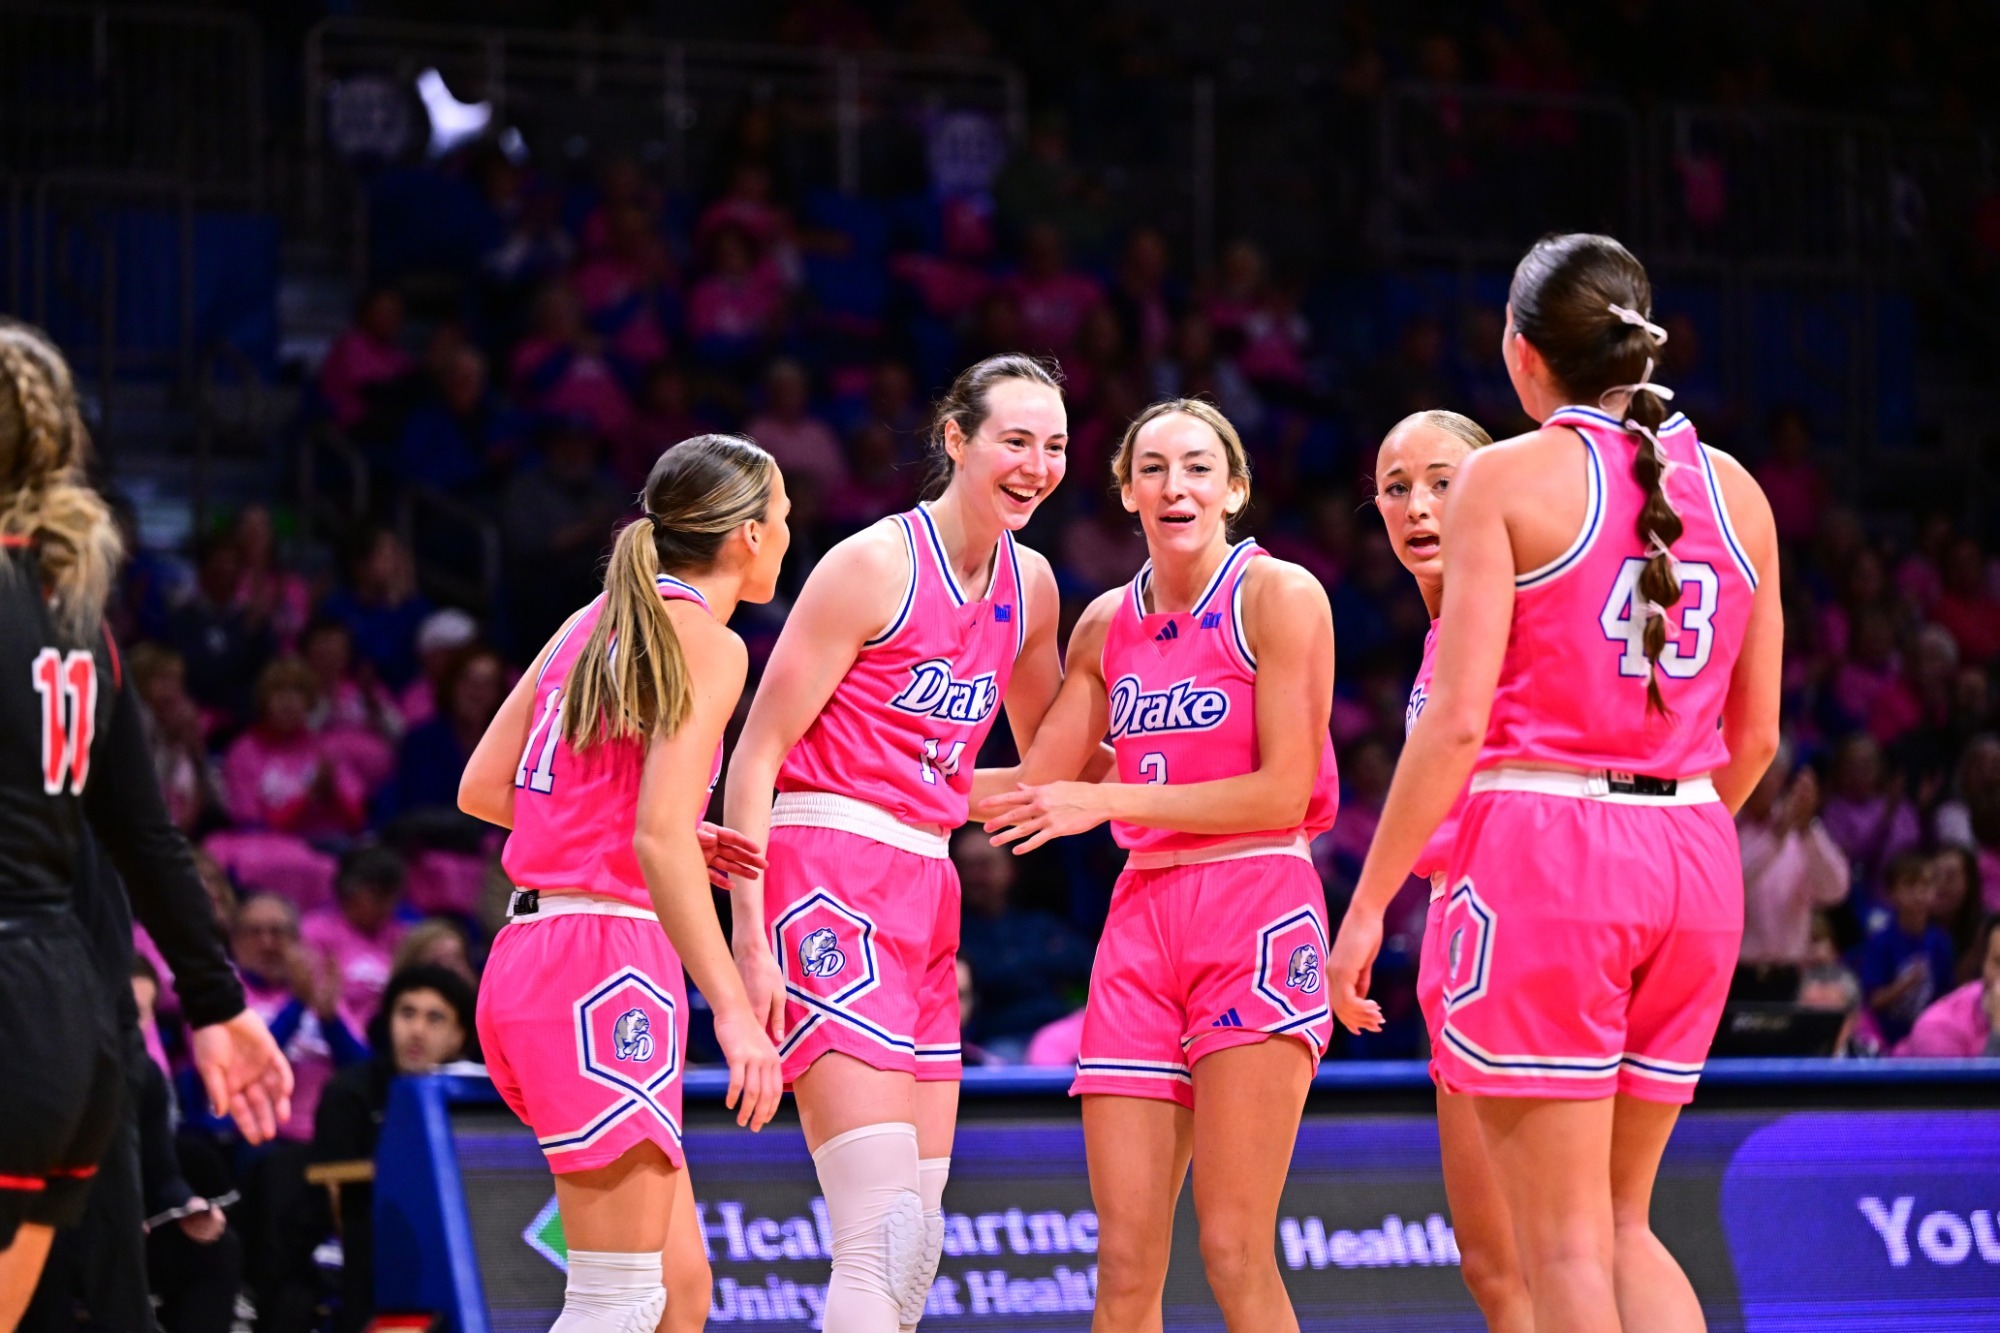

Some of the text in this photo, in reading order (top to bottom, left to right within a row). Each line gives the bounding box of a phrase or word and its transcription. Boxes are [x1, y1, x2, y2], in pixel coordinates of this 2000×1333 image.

[1598, 556, 1720, 680] 43
[32, 647, 98, 796] 11
[886, 657, 998, 725] Drake
[1110, 674, 1230, 741] Drake
